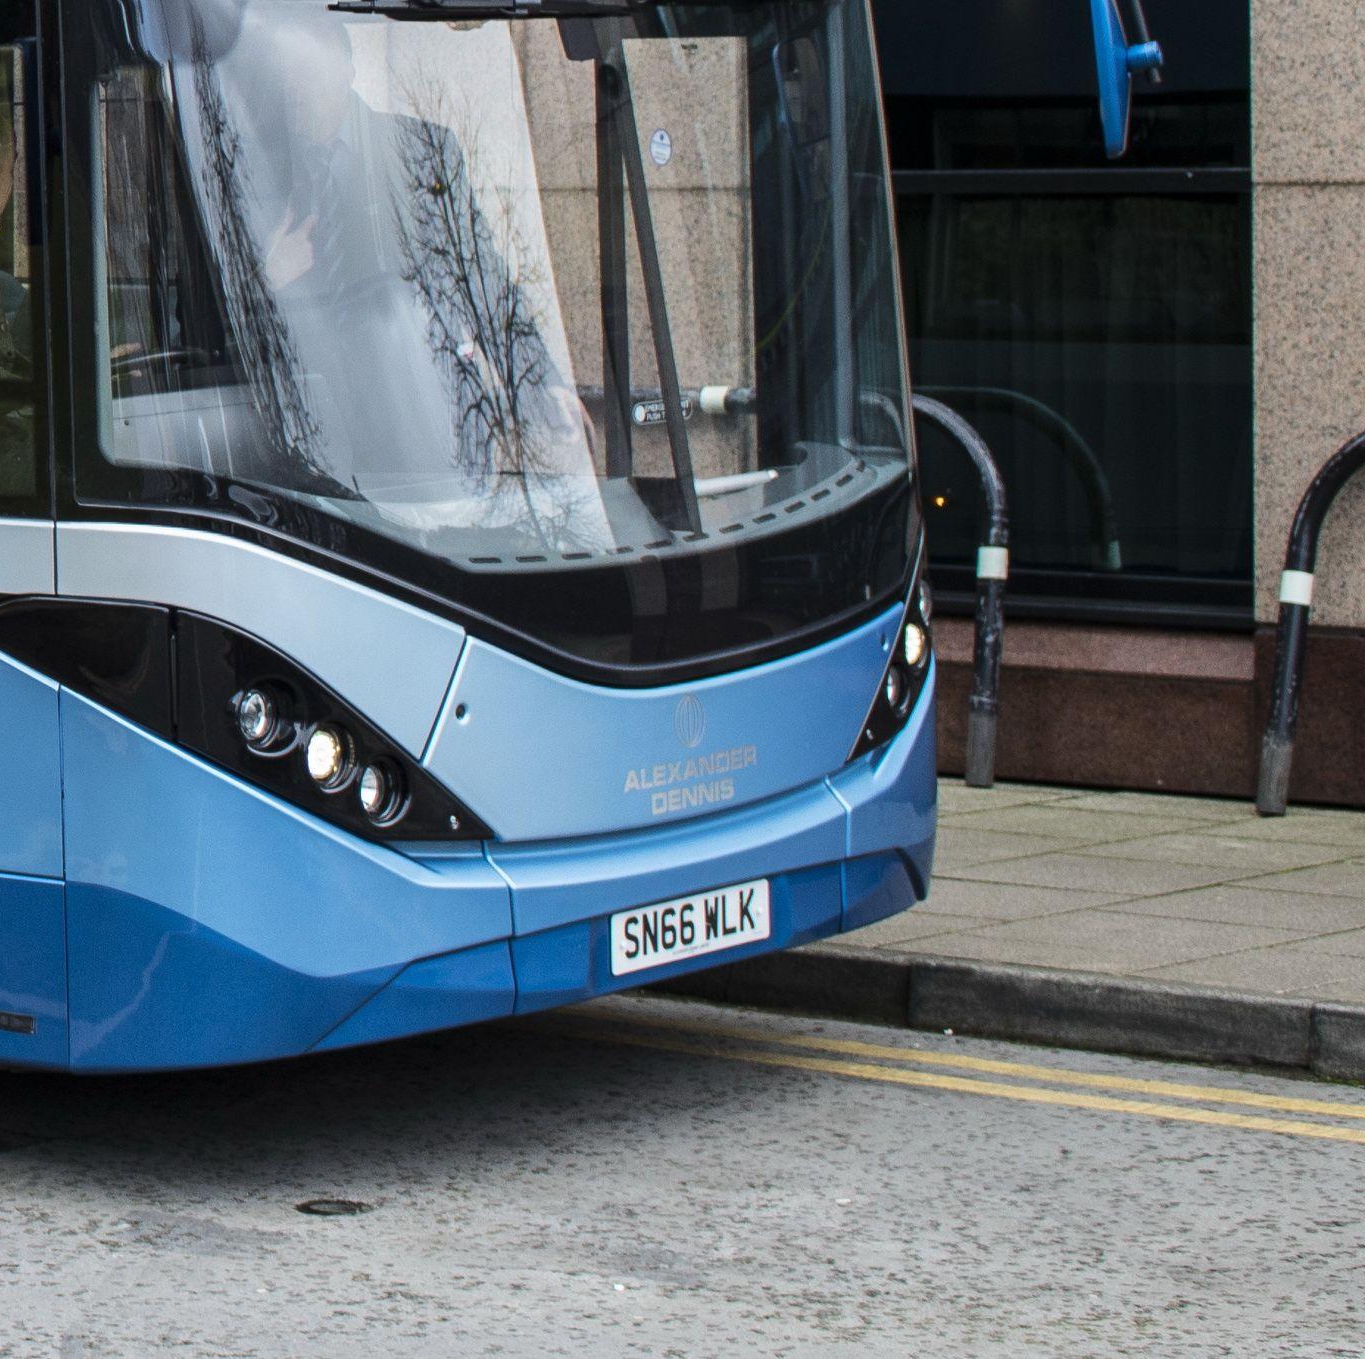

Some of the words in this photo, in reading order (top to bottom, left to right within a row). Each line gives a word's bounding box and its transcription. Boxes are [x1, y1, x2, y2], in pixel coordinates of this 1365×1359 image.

[625, 746, 756, 793] ALEXANDER
[652, 779, 734, 815] DENNIS
[624, 903, 696, 960] SN66
[704, 887, 755, 941] WLK
